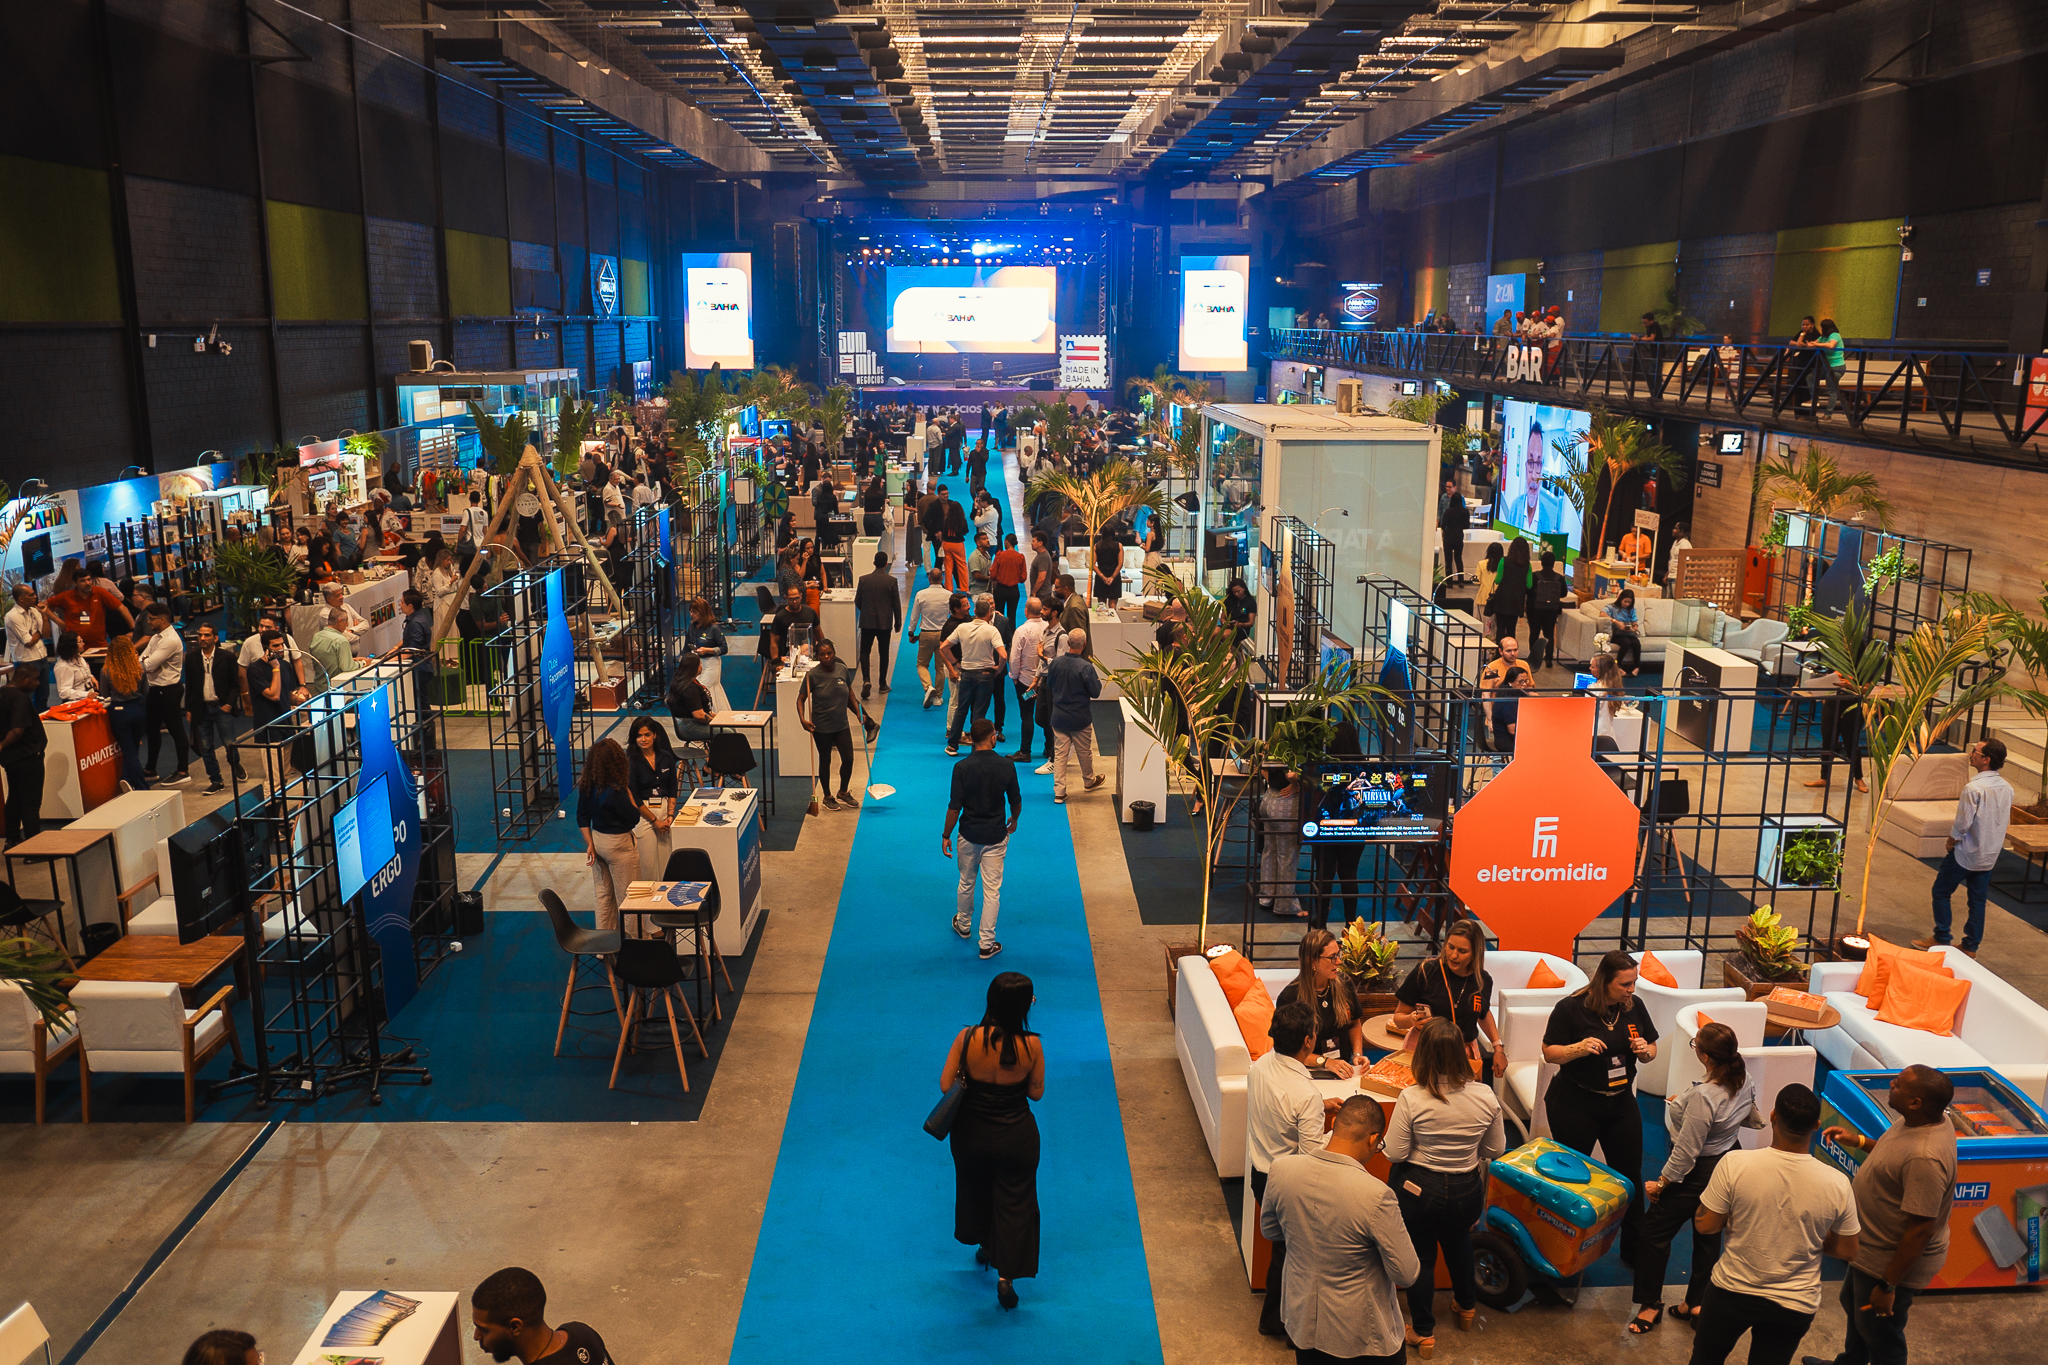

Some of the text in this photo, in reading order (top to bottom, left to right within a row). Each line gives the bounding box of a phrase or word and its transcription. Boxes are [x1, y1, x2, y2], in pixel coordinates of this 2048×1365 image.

[1206, 305, 1235, 313] BAHIA
[947, 314, 976, 322] BAHIA
[877, 366, 884, 374] DE
[1066, 366, 1099, 374] MADE IN
[1507, 345, 1542, 381] BAR
[1066, 374, 1090, 382] BAHIA
[24, 506, 68, 532] BAHIA
[370, 602, 396, 629] BAHIA
[1362, 791, 1391, 801] NIRVANA
[371, 853, 402, 898] ERGO
[1476, 862, 1608, 882] eletromidia
[1540, 1210, 1576, 1236] CAPELINHA
